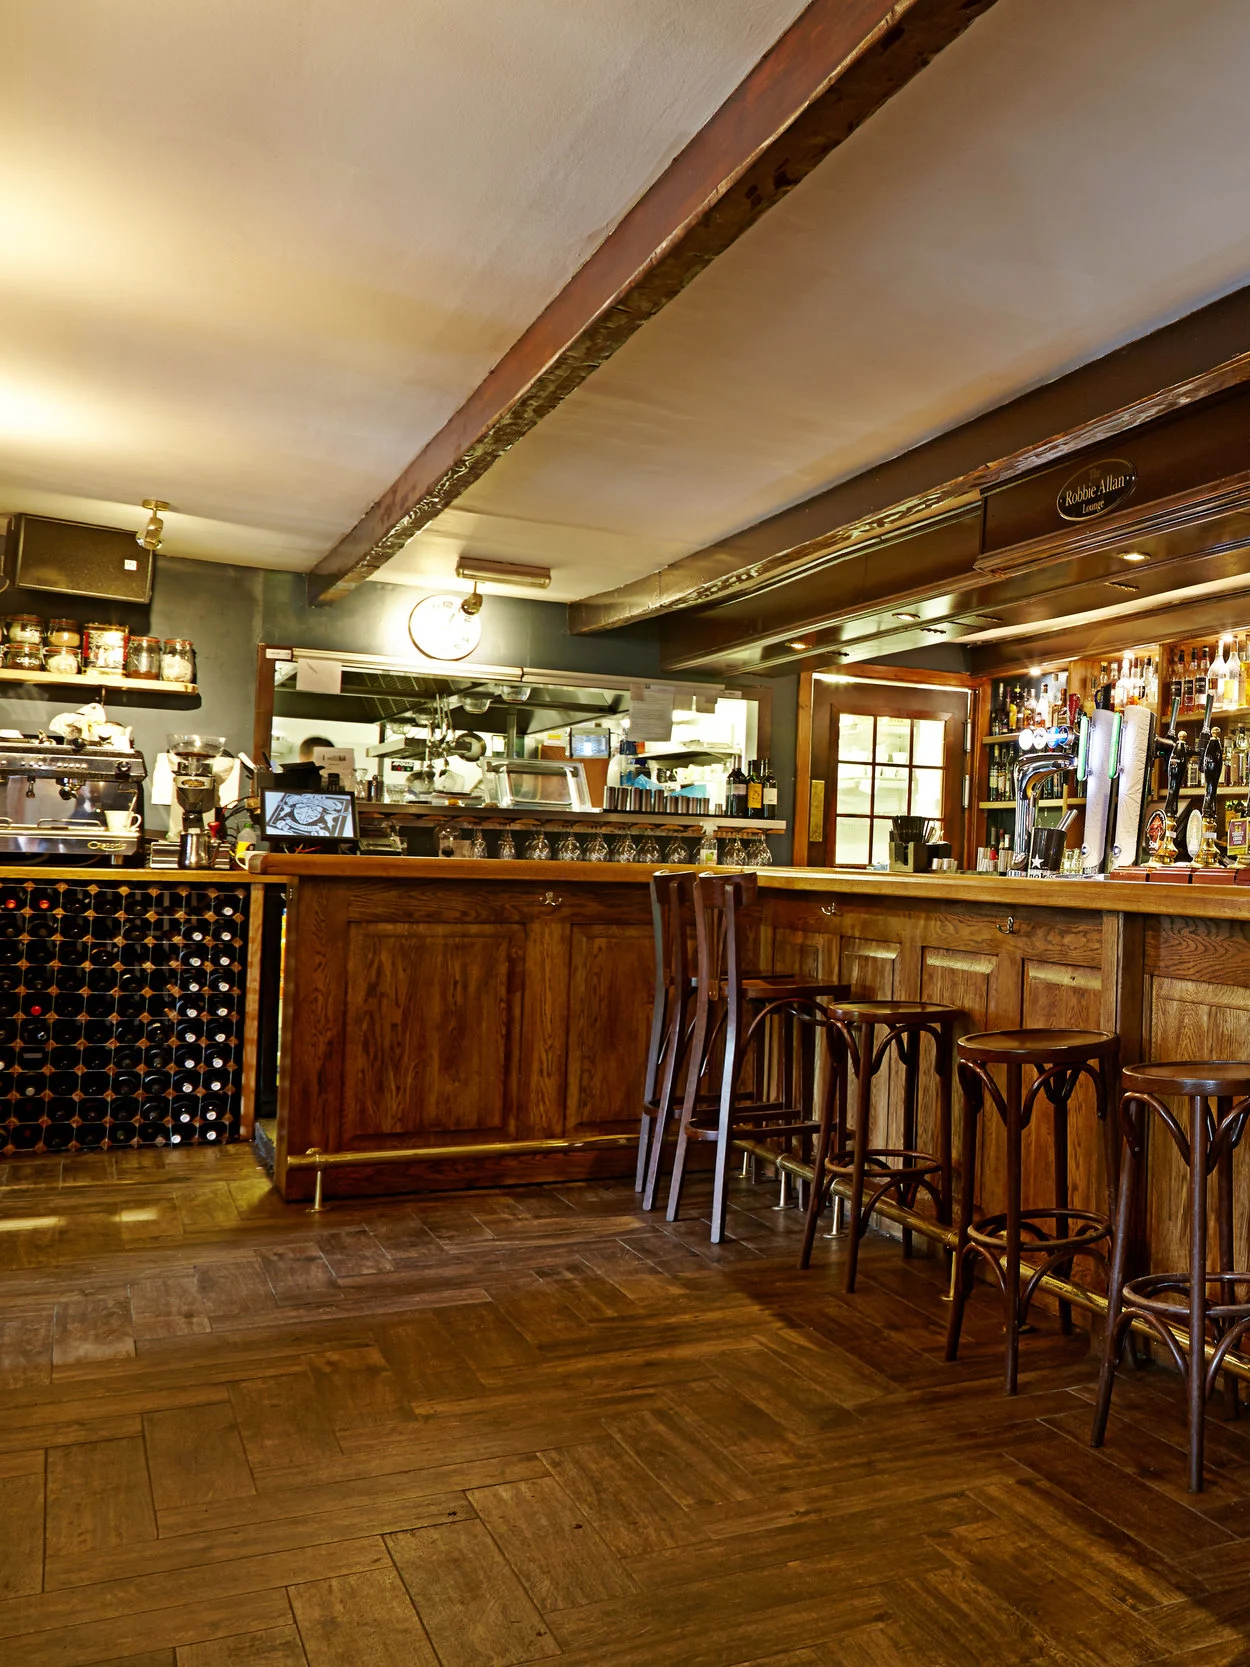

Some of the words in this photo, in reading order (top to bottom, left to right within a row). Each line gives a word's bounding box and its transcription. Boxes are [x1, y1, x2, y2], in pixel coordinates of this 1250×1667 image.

[1065, 483, 1097, 507] Robbie
[1098, 474, 1125, 495] Allan
[1082, 500, 1105, 514] Lounge
